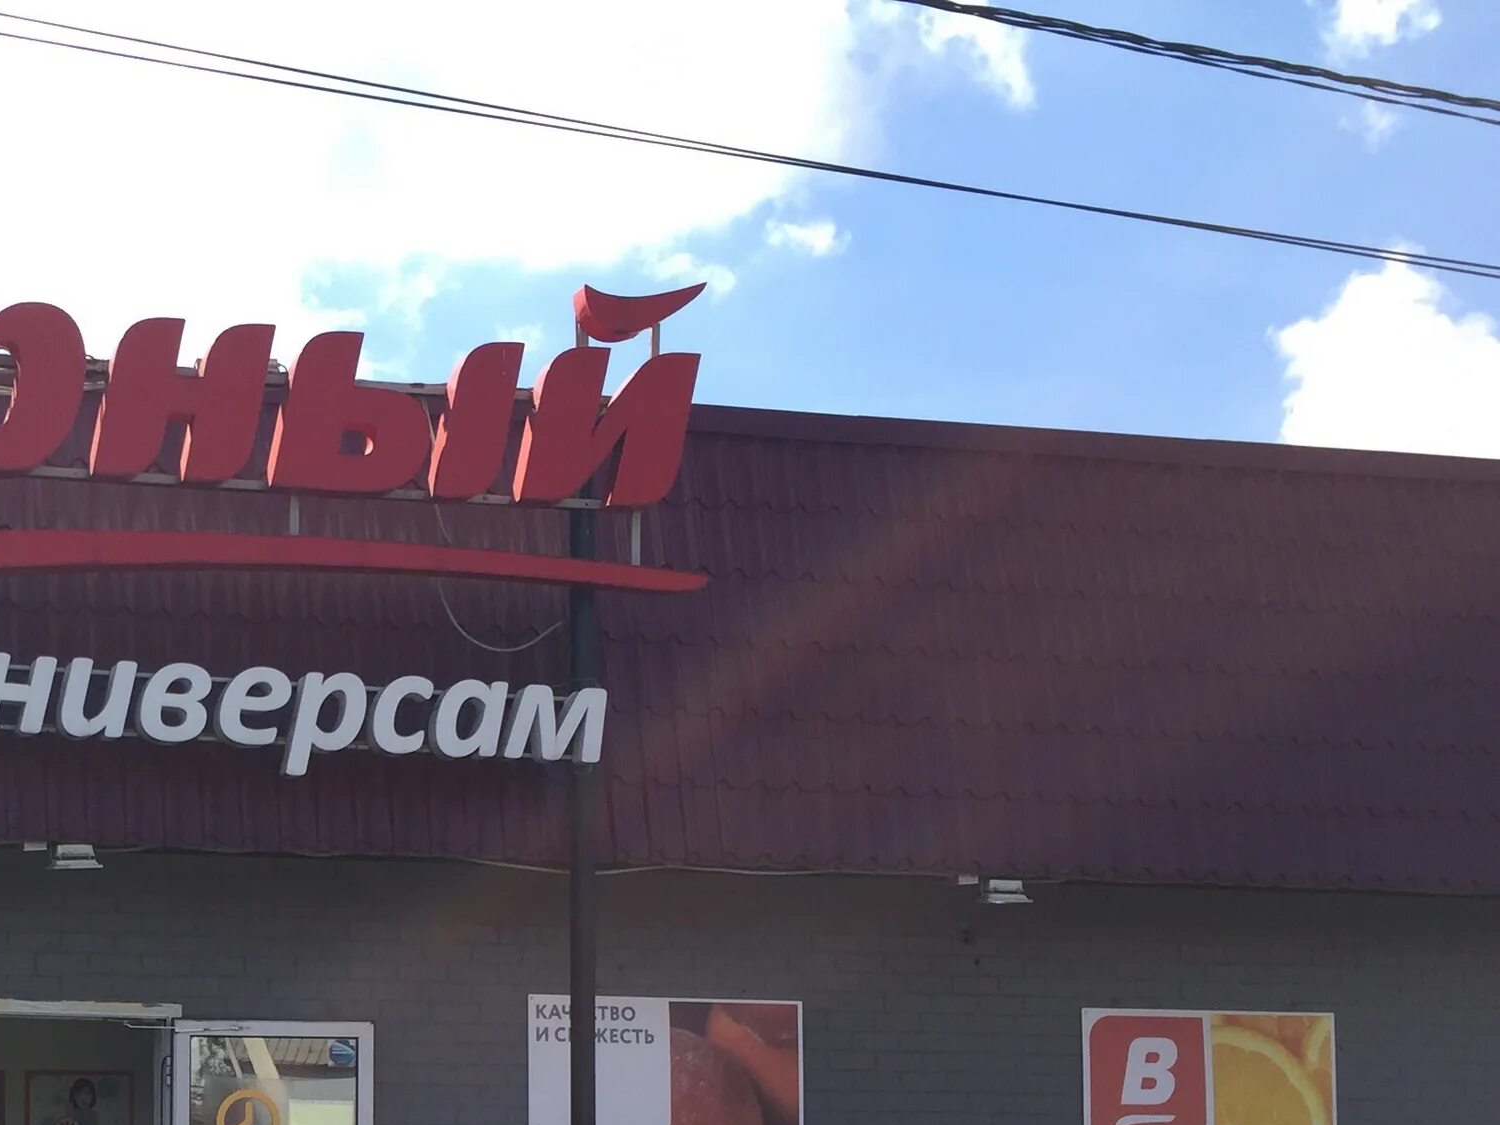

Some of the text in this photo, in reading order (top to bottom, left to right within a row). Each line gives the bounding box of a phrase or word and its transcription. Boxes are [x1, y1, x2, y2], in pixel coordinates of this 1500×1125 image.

[536, 1004, 636, 1022] КАЧТВО
[536, 1026, 655, 1044] И СЖЕСТЬ
